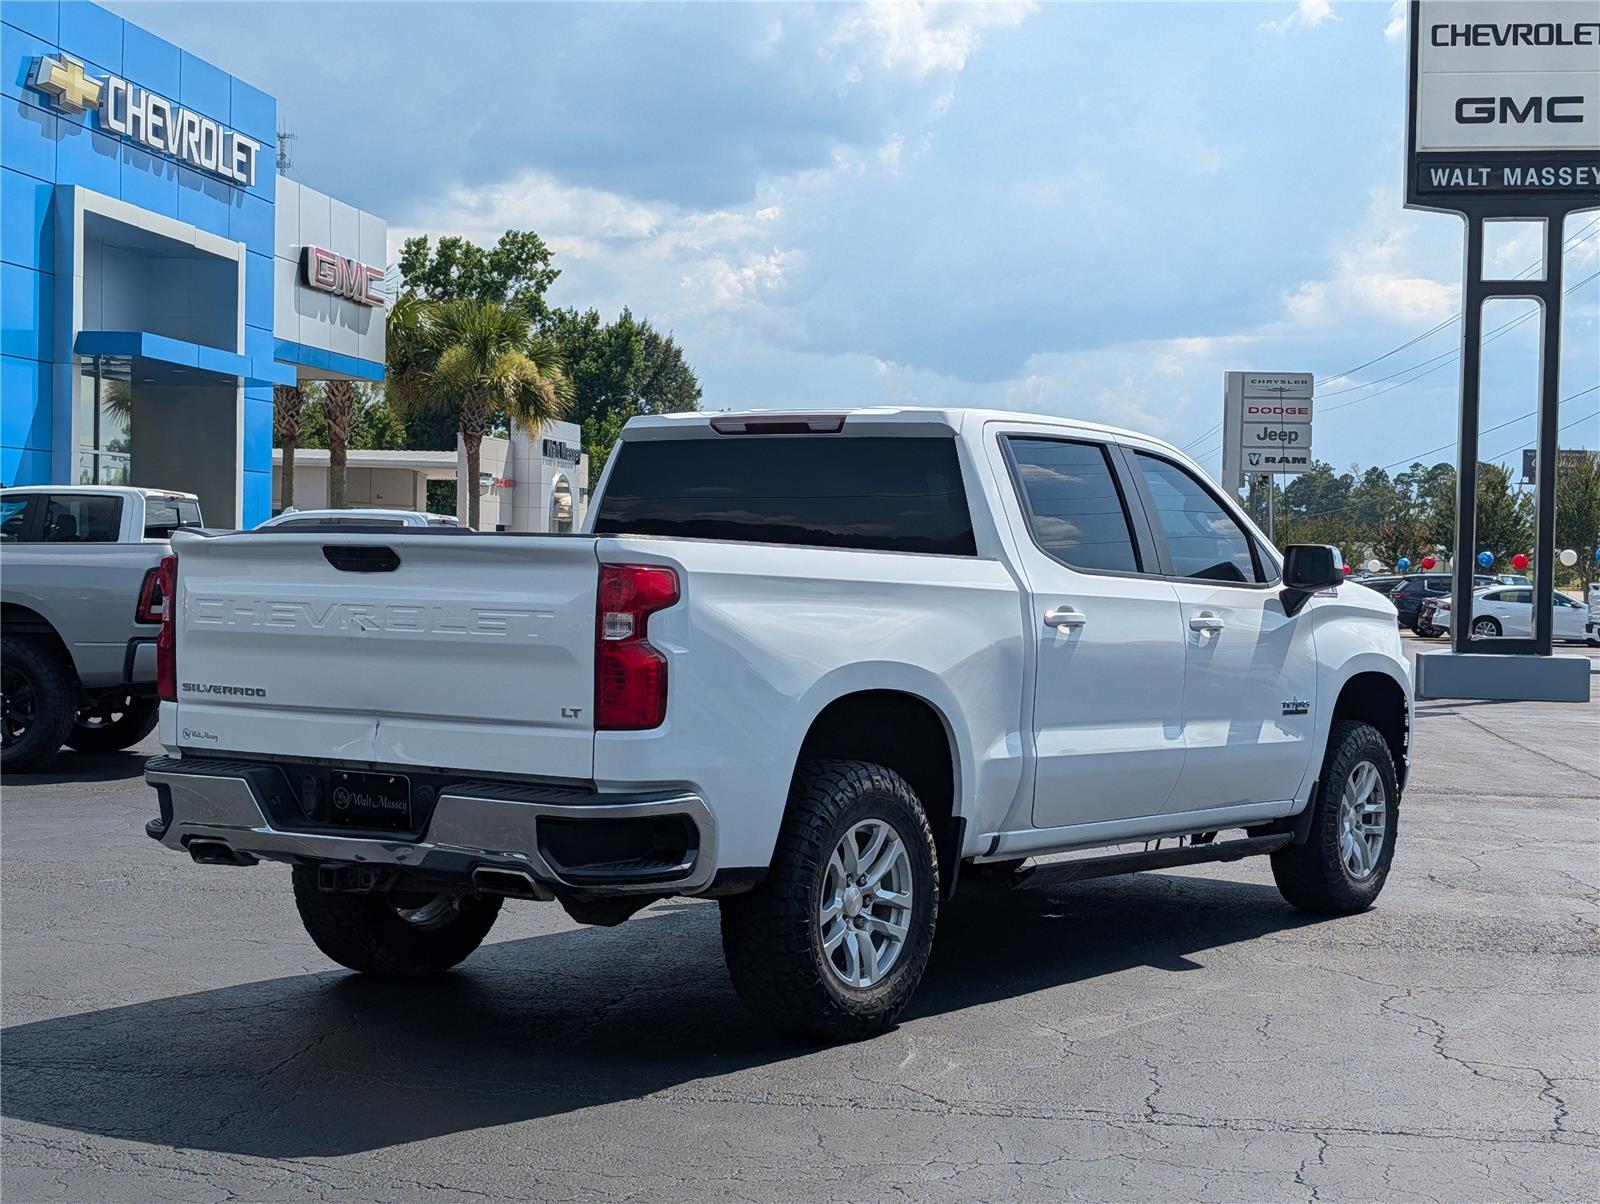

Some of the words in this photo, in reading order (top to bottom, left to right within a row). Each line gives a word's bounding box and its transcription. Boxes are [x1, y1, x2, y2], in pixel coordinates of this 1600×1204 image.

[1455, 96, 1584, 124] GMC
[107, 75, 260, 187] CHEVROLET
[1430, 168, 1491, 187] WALT
[310, 245, 385, 307] GMC
[1248, 406, 1309, 415] DODGE
[1256, 427, 1299, 444] Jeep
[1264, 456, 1307, 465] RAM
[195, 598, 555, 637] CHEVROLET
[182, 683, 266, 697] SILVERADO
[560, 707, 582, 719] LT
[350, 793, 372, 807] Walt
[372, 795, 407, 814] Massey
